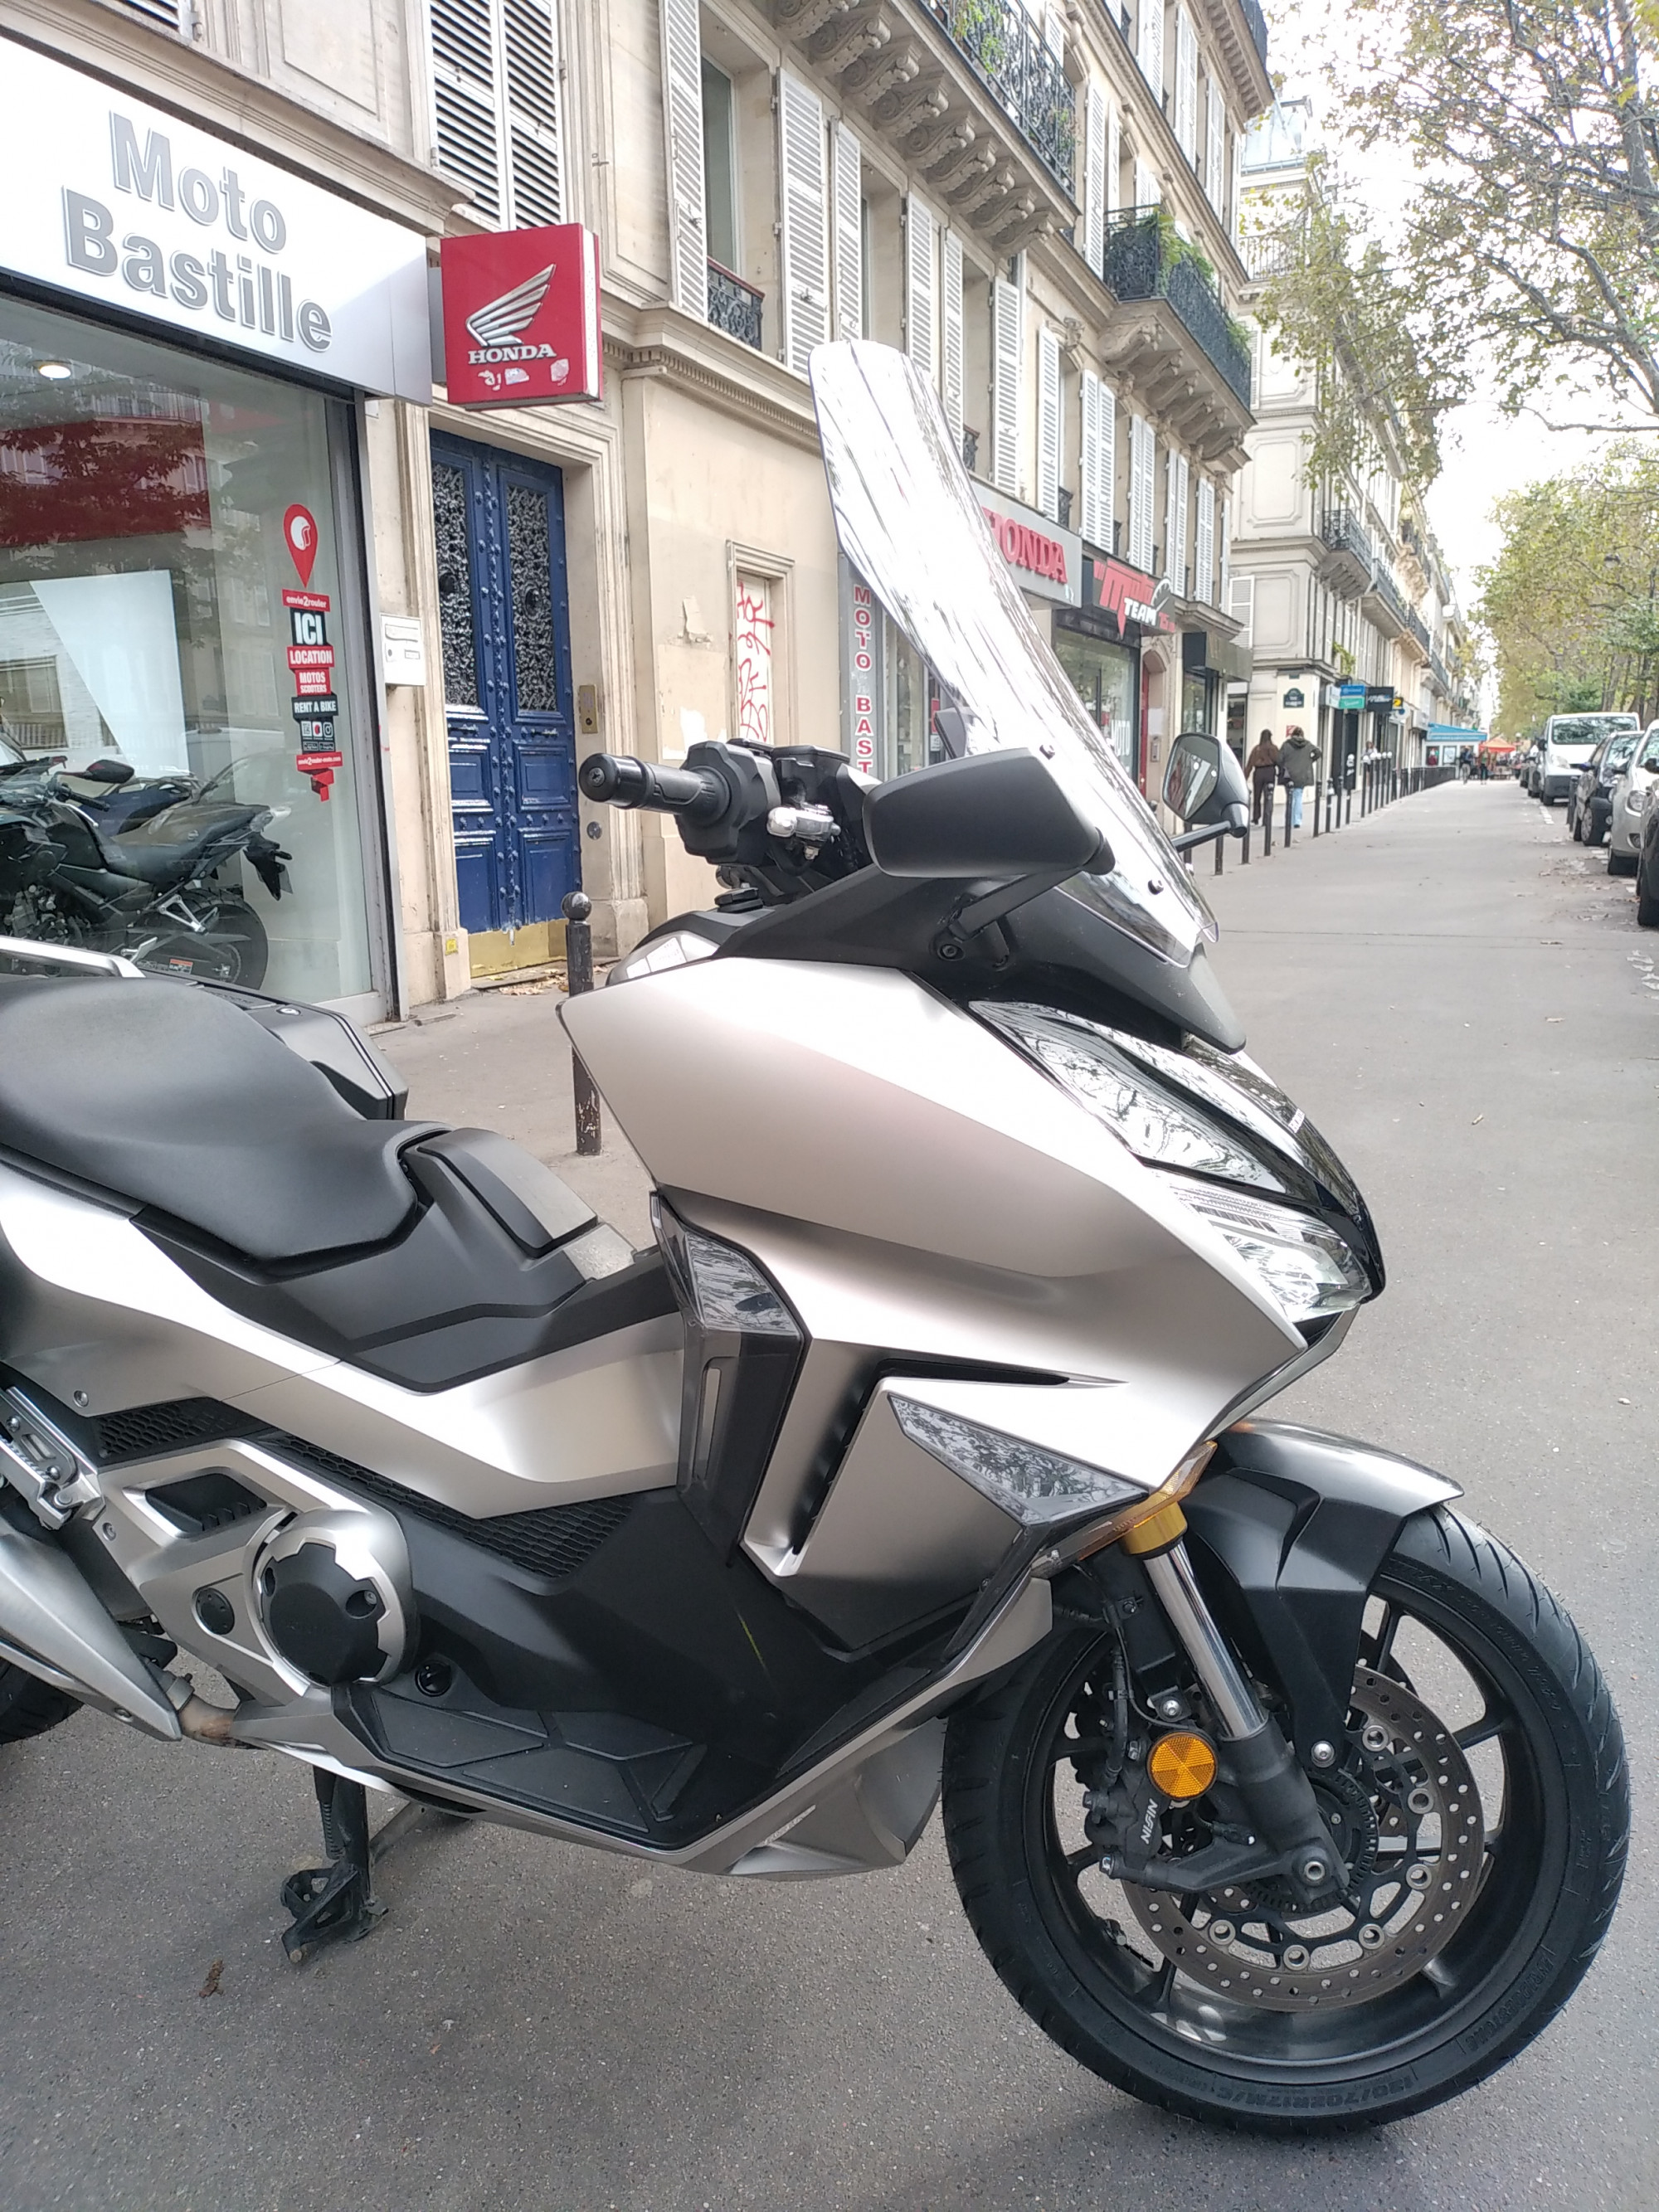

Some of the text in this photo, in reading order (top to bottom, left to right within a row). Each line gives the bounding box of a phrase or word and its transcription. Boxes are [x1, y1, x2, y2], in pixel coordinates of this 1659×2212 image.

[109, 109, 288, 255] Moto
[61, 184, 333, 354] Bastille
[468, 343, 557, 365] HONDA
[1124, 596, 1157, 626] TEAM
[294, 612, 324, 645] ICI
[854, 585, 872, 671] MOTO
[289, 649, 333, 664] LOCATION
[299, 672, 326, 683] MOTOS
[299, 684, 327, 693] SCOOTERS
[294, 700, 337, 713] RENT A BIKE
